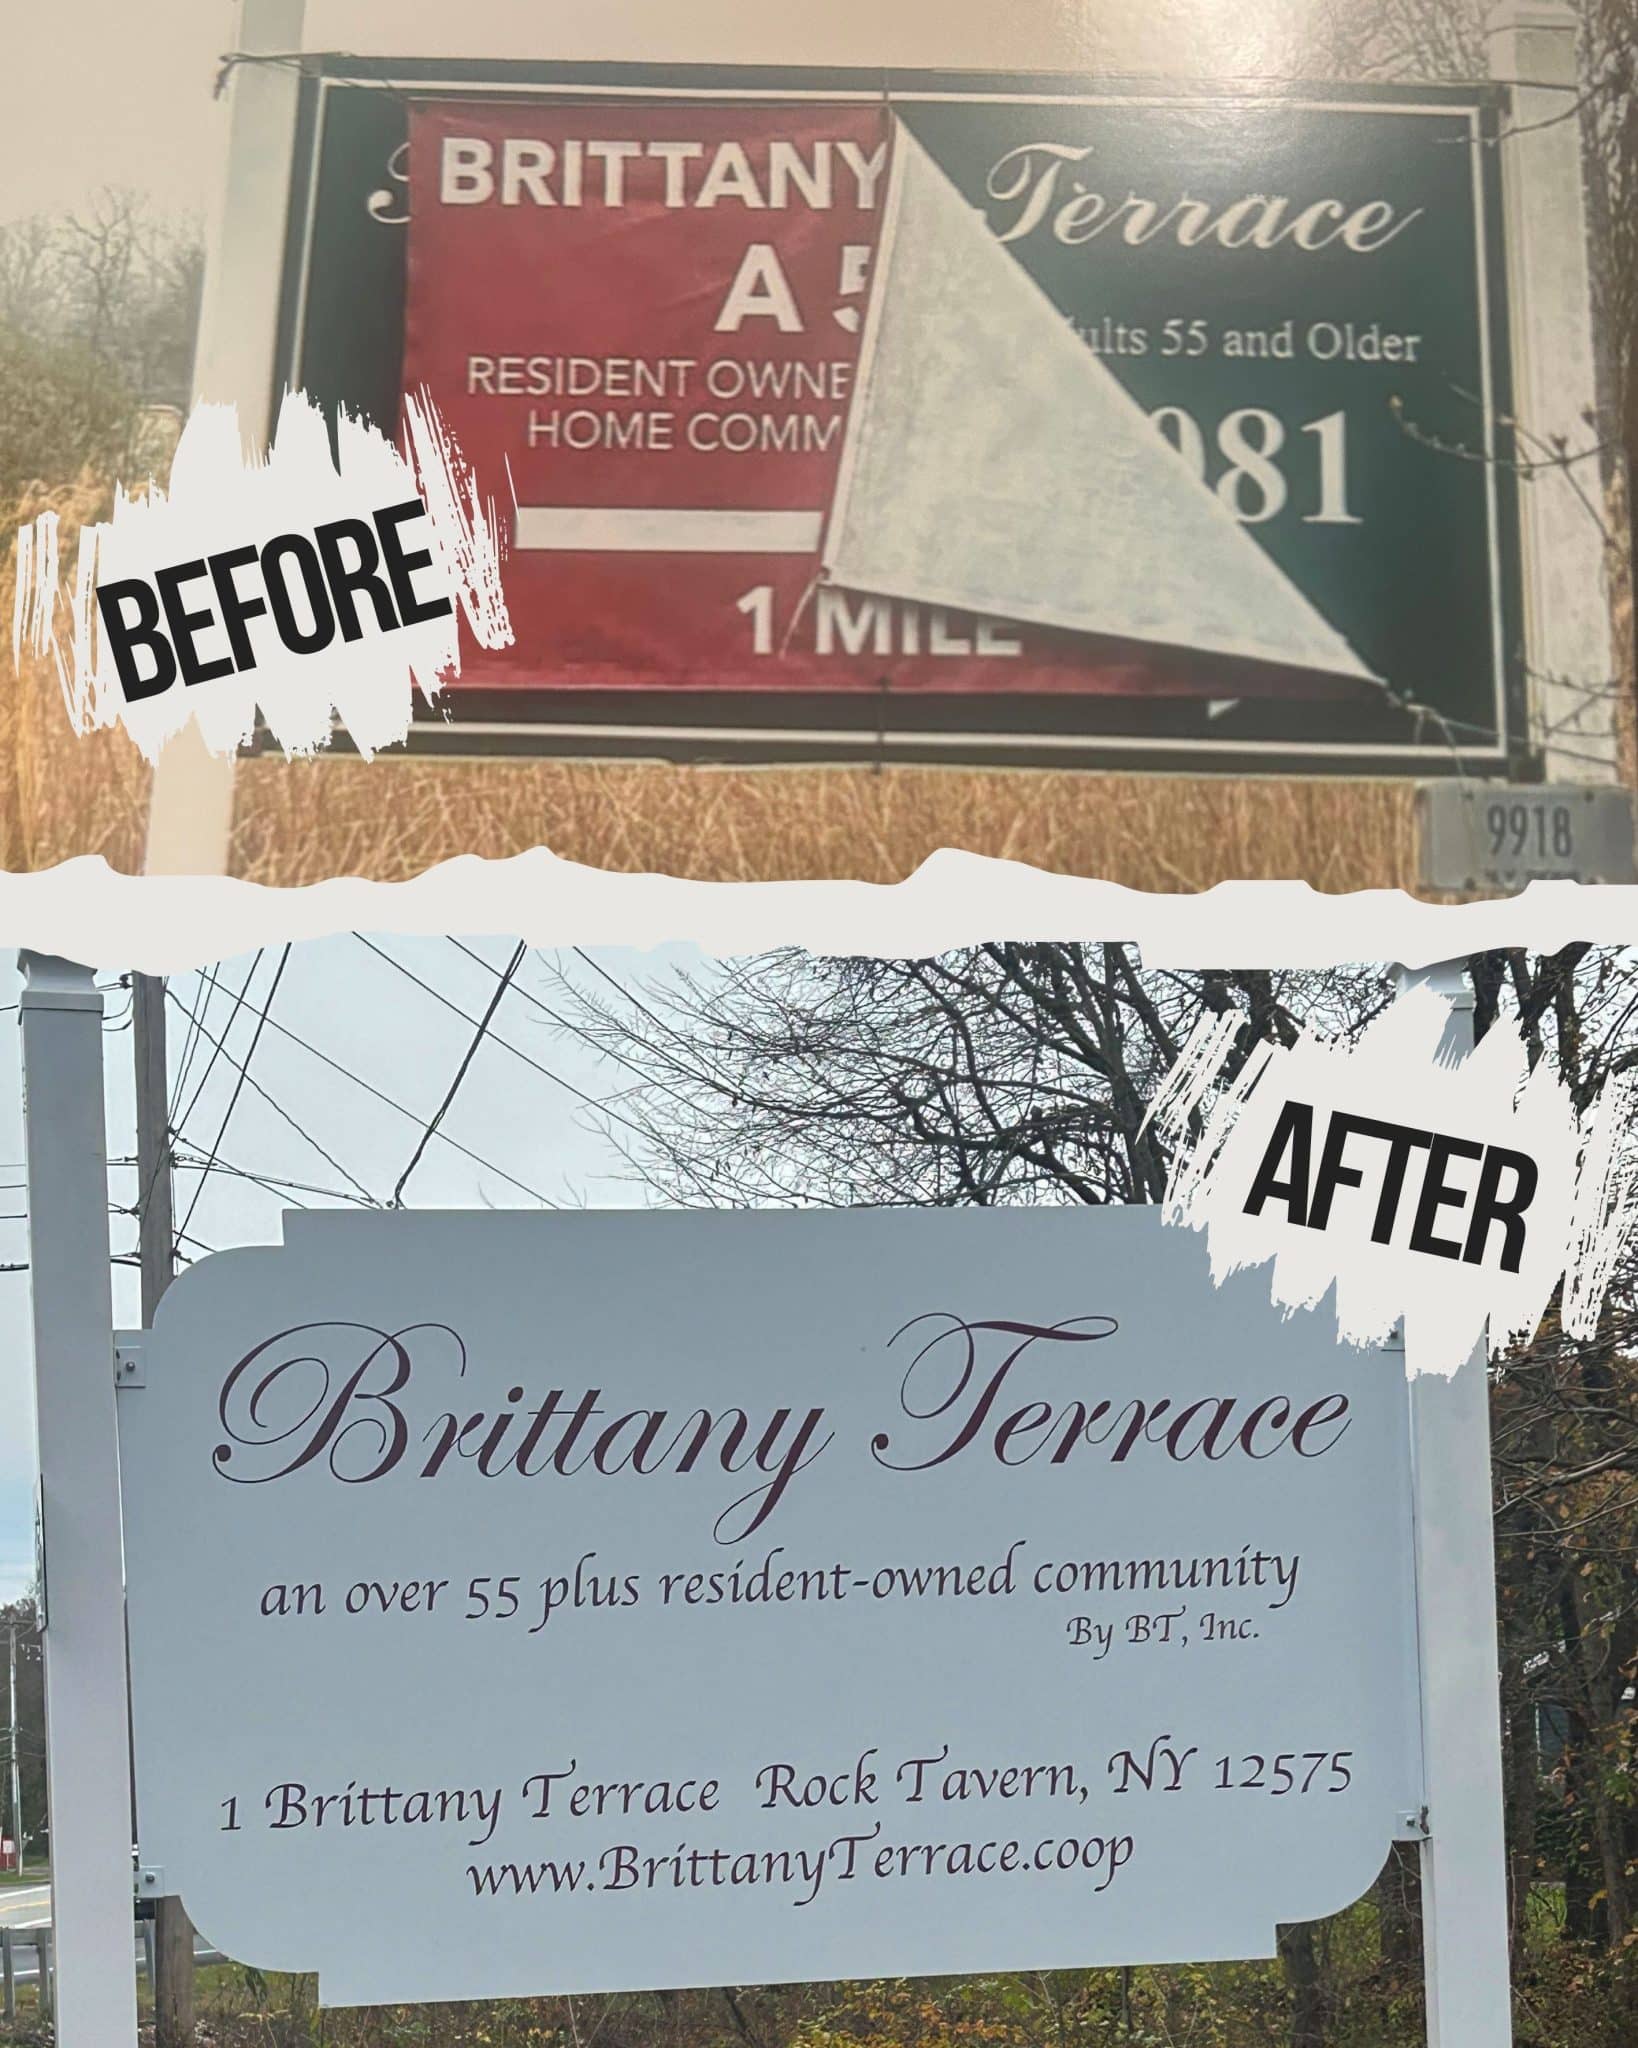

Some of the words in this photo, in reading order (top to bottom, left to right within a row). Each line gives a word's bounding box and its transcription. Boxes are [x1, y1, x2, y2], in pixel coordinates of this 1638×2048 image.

[439, 136, 888, 209] BRITTANY
[986, 141, 1425, 253] Terrace
[714, 243, 805, 333] A
[467, 356, 698, 396] RESIDENT
[1160, 317, 1209, 357] 55
[1223, 322, 1294, 359] and
[1307, 321, 1423, 363] Older
[528, 410, 675, 448] HOME
[736, 585, 774, 656] 1
[815, 588, 1023, 657] MILE
[1487, 804, 1572, 858] 9918
[212, 1321, 836, 1545] Brittany
[870, 1312, 1353, 1471] Terrace
[260, 1583, 327, 1617] an
[345, 1576, 450, 1614] over
[465, 1575, 521, 1620] 55
[527, 1551, 641, 1634] plus
[658, 1540, 1027, 1606] resident-owned
[1033, 1543, 1300, 1610] community
[1065, 1615, 1115, 1661] By
[1125, 1604, 1188, 1648] BT,
[1199, 1612, 1260, 1642] Inc.
[219, 1796, 243, 1832] 1
[264, 1780, 504, 1847] Brittany
[521, 1758, 721, 1820] Terrace
[755, 1747, 881, 1809] Rock
[895, 1743, 1089, 1806] Tavern,
[1107, 1734, 1199, 1795] NY
[1213, 1750, 1354, 1797] 12575
[465, 1820, 1135, 1908] www.BrittanyTerrace.coop
